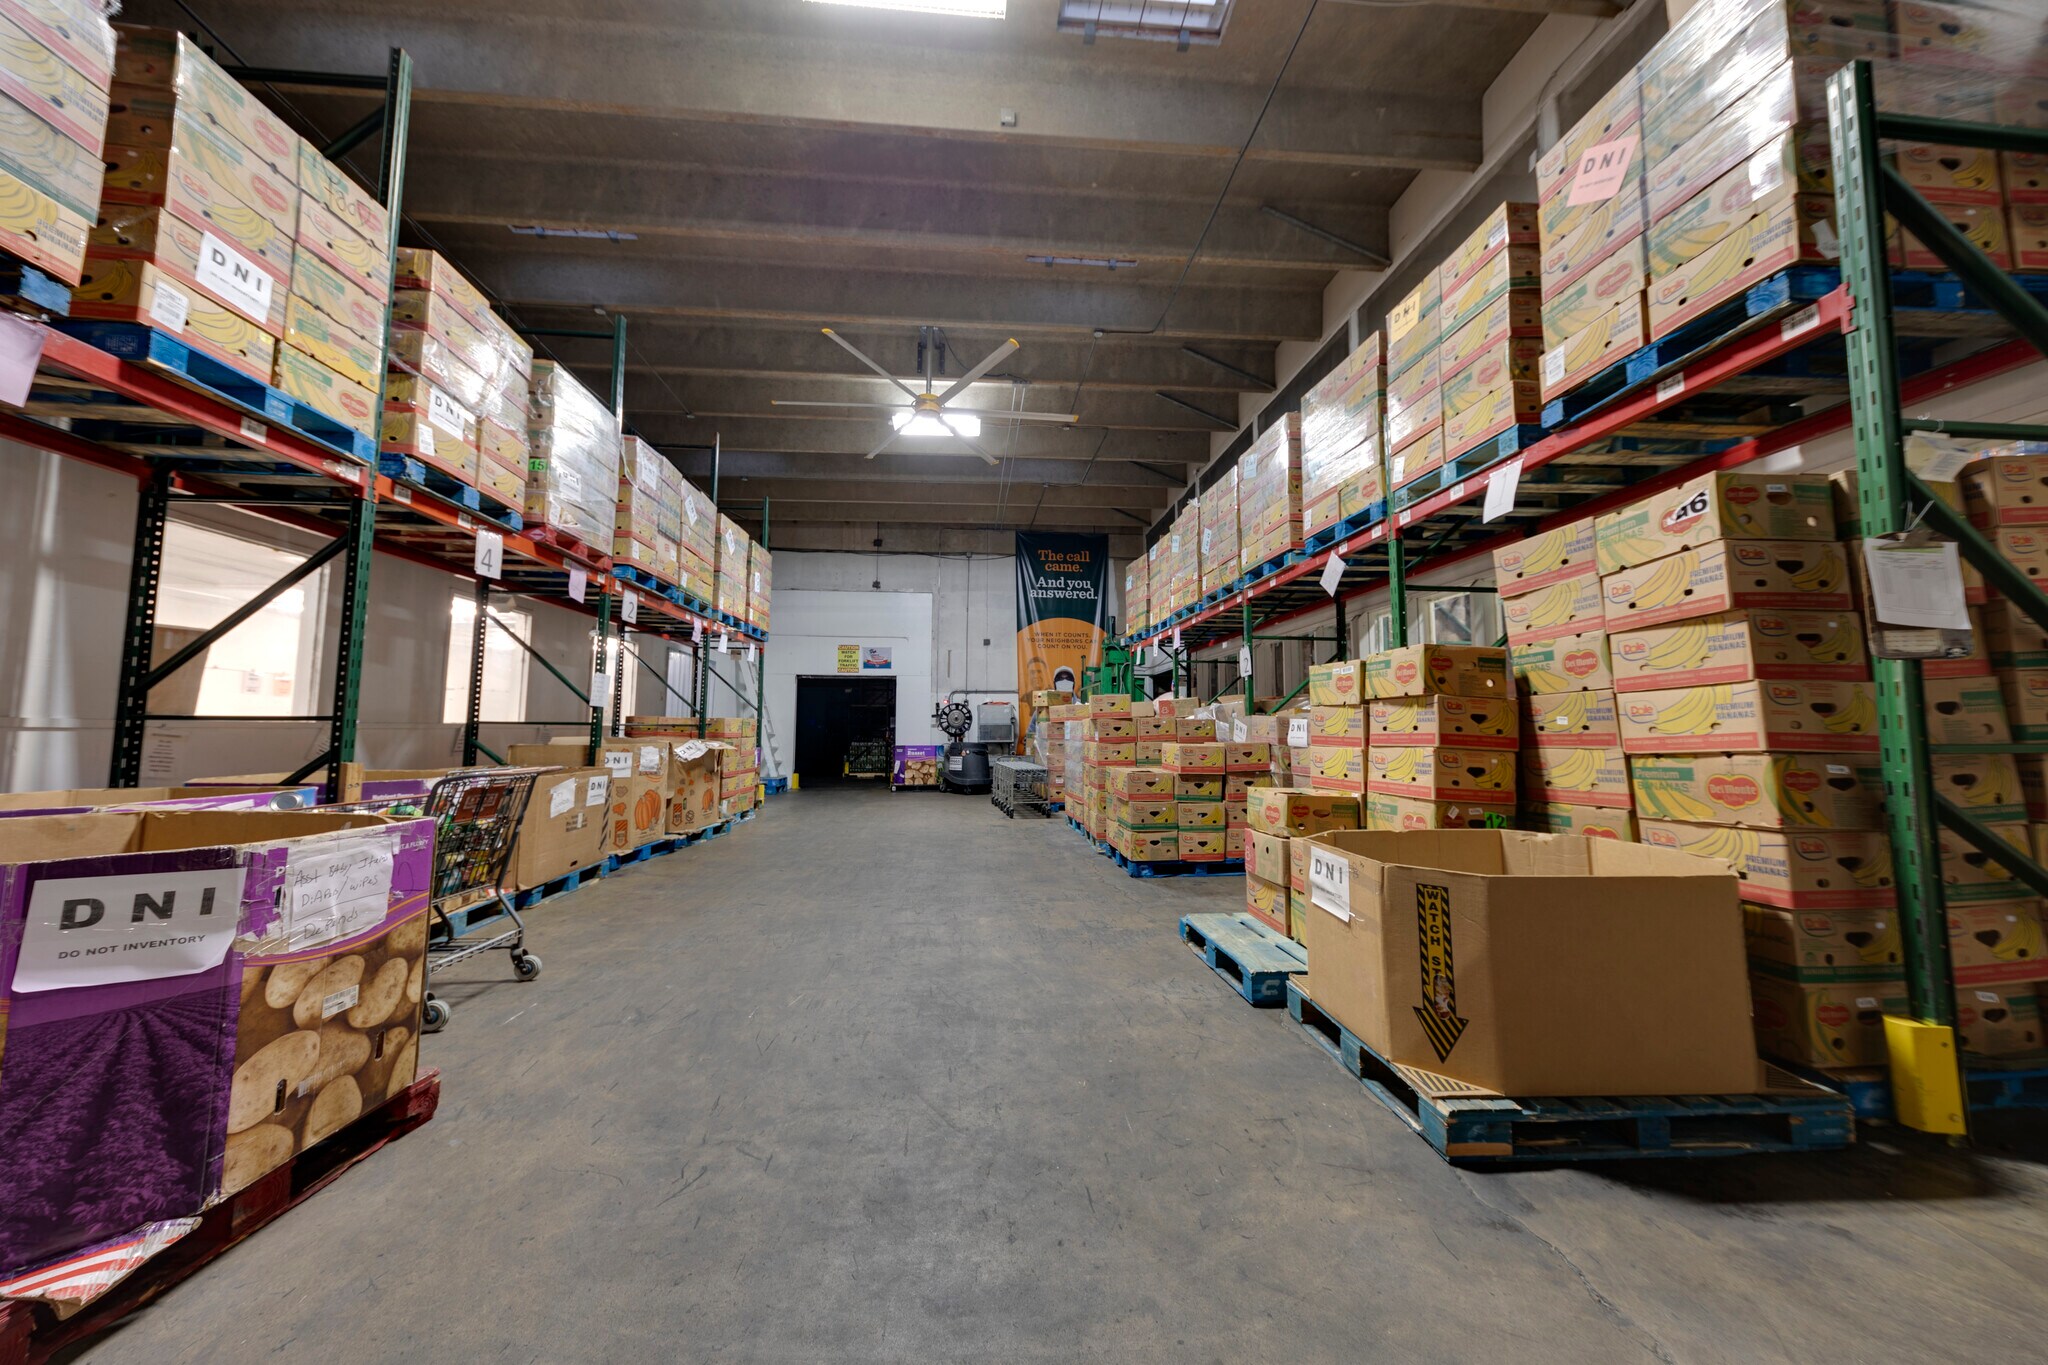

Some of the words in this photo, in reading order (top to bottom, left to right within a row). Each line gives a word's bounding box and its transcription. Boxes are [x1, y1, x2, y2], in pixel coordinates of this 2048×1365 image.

[1584, 147, 1626, 174] DNI
[529, 460, 545, 471] 15
[1599, 518, 1636, 538] Premium
[1565, 535, 1593, 549] PREMIUM
[1566, 543, 1594, 556] BANANAS
[1740, 547, 1765, 557] Dole
[481, 548, 493, 573] 4
[1038, 550, 1063, 562] The
[1066, 551, 1090, 562] call
[1503, 556, 1521, 565] Dole
[1045, 563, 1083, 573] came.
[1690, 563, 1723, 577] PREMIUM
[1036, 576, 1065, 588] And
[1066, 580, 1091, 590] you
[1690, 572, 1724, 587] BANANAS
[1030, 588, 1098, 600] answered.
[1611, 584, 1632, 596] Dole
[628, 602, 635, 619] 2
[1510, 607, 1528, 617] Dole
[1760, 618, 1786, 628] Dole
[1706, 632, 1745, 644] PREMIUM
[1623, 642, 1645, 652] Dole
[1708, 641, 1746, 652] BANANAS
[1513, 655, 1544, 665] Premium
[1565, 660, 1576, 668] Del
[1576, 658, 1597, 667] Monte
[1772, 687, 1798, 697] Dole
[1447, 701, 1463, 710] Dole
[1630, 704, 1654, 715] Dole
[1716, 701, 1754, 711] PREMIUM
[1375, 709, 1387, 717] Dole
[1716, 710, 1756, 721] BANANAS
[1291, 724, 1306, 732] DNI
[1443, 755, 1459, 763] Dole
[1635, 769, 1680, 780] Premium
[591, 781, 606, 791] DNI
[1638, 781, 1689, 792] BANANAS
[1709, 783, 1723, 793] Del
[1724, 783, 1757, 795] Monte
[1487, 813, 1505, 829] 12
[1652, 833, 1676, 845] Dole
[1745, 855, 1788, 867] PREMIUM
[1315, 858, 1343, 885] DNI
[1745, 863, 1789, 878] BANANAS
[59, 887, 216, 931] DNI
[1425, 890, 1442, 947] WATCH
[58, 950, 80, 960] DO
[86, 945, 119, 956] NOT
[123, 934, 206, 952] INVENTORY
